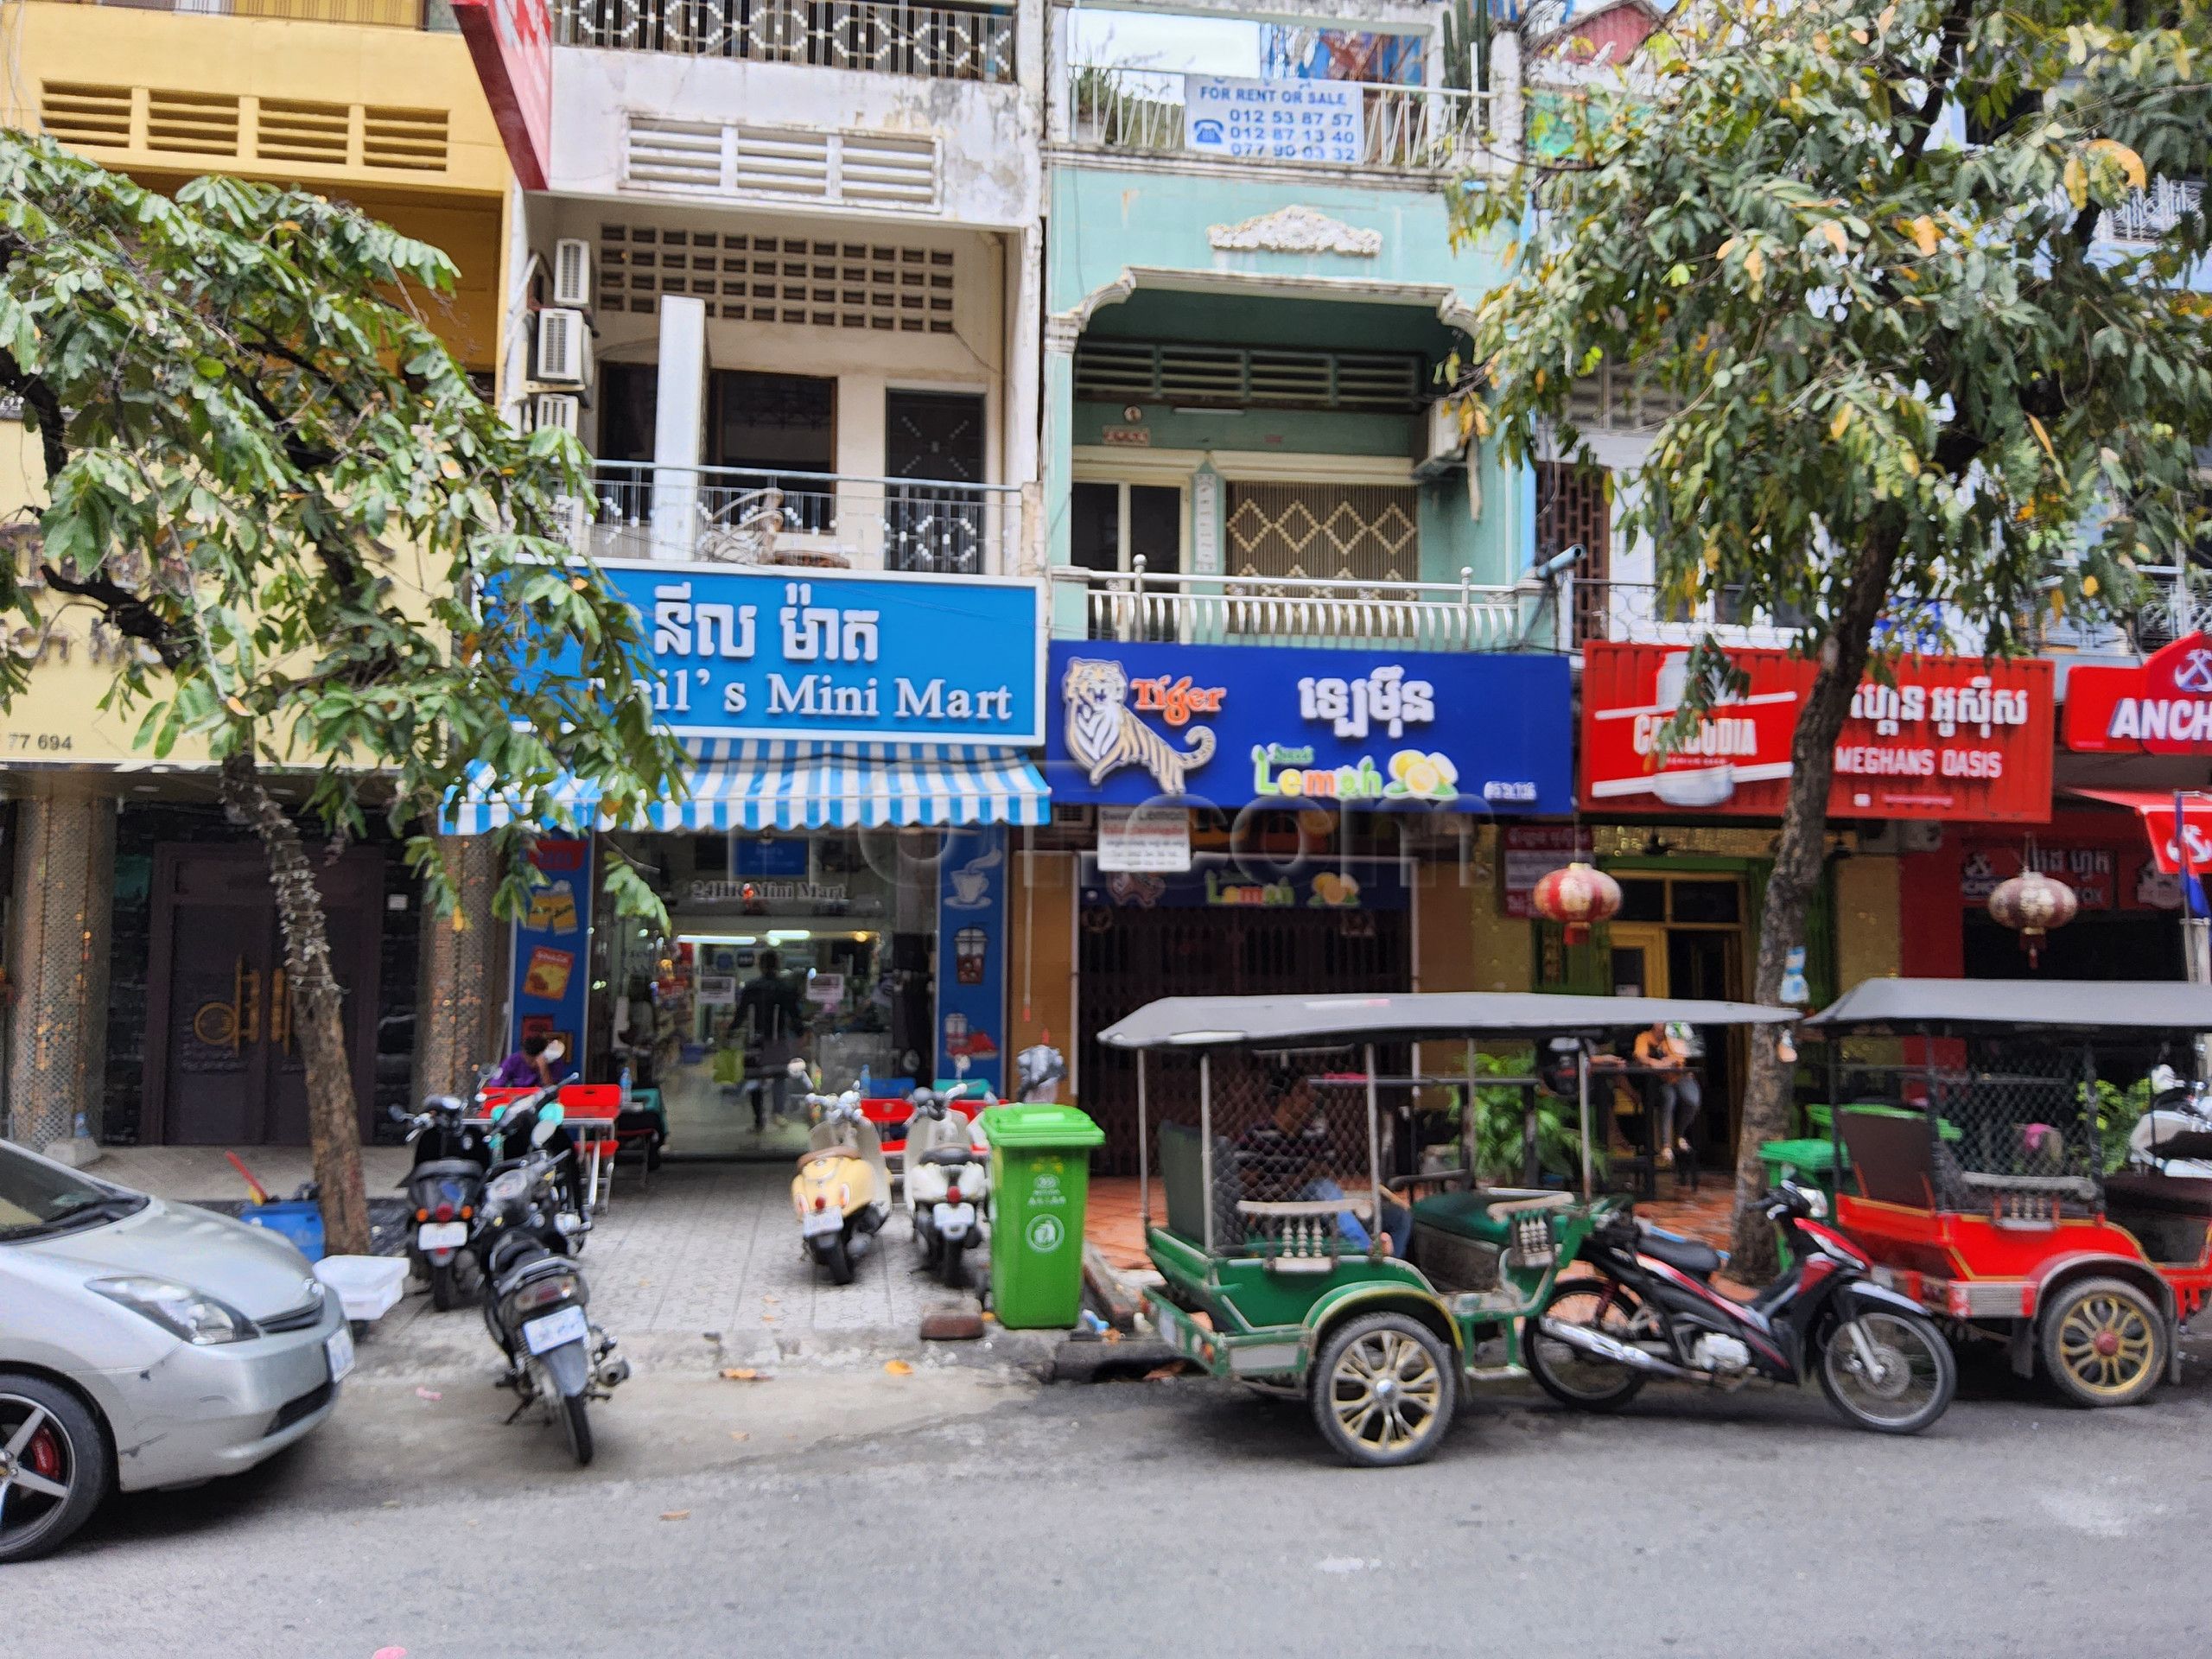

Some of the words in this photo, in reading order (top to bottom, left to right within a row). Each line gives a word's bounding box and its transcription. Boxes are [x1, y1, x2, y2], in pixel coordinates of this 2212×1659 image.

[1200, 86, 1230, 100] FOR
[1236, 88, 1276, 103] RENT
[1281, 90, 1302, 104] OR
[1307, 92, 1347, 106] SALE
[1230, 109, 1265, 124] 012
[1273, 111, 1294, 124] 53
[1302, 112, 1324, 126] 87
[1332, 113, 1354, 127] 57
[1230, 126, 1266, 140] 012
[1273, 128, 1294, 141] 87
[1304, 130, 1325, 143] 13
[1332, 130, 1355, 143] 40
[1230, 144, 1265, 157] 077
[1274, 144, 1296, 158] 90
[1332, 148, 1355, 162] 32
[766, 673, 880, 717] Mini
[893, 677, 1013, 721] Mart
[1130, 674, 1227, 727] Tiger
[38, 734, 73, 750] 694
[1941, 748, 2003, 779] OASIS
